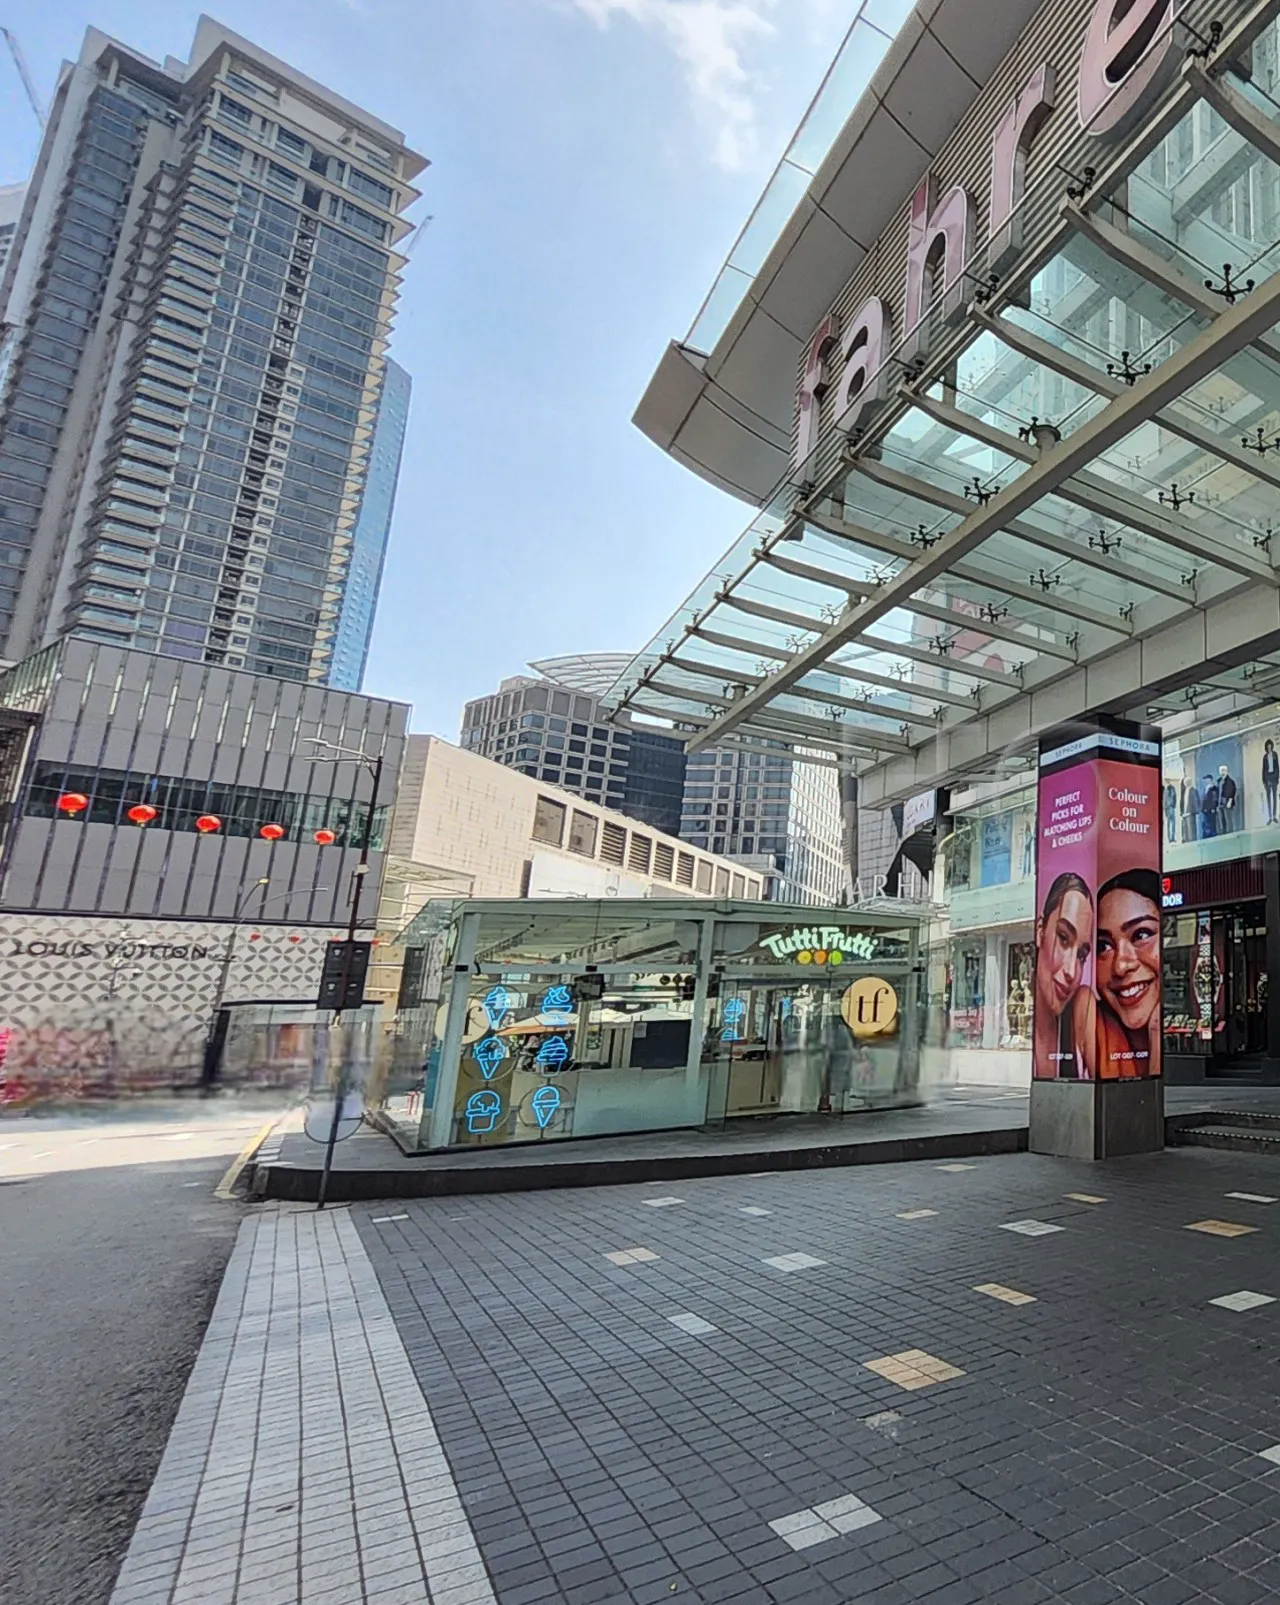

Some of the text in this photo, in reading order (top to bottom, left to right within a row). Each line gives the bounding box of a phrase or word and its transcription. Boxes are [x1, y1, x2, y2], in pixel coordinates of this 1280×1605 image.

[1109, 737, 1151, 752] SEPHORA
[1055, 791, 1081, 807] PERFECT
[1108, 787, 1149, 805] Colour
[1052, 804, 1084, 821] PICKS FOR
[1122, 807, 1137, 818] on
[1043, 815, 1092, 837] MATCHING LIPS
[1109, 817, 1150, 834] Colour
[1058, 832, 1083, 847] CHEEKS
[14, 939, 209, 960] LOUIS VUITTON
[759, 927, 880, 960] Tutti Frutti
[855, 986, 890, 1024] tf
